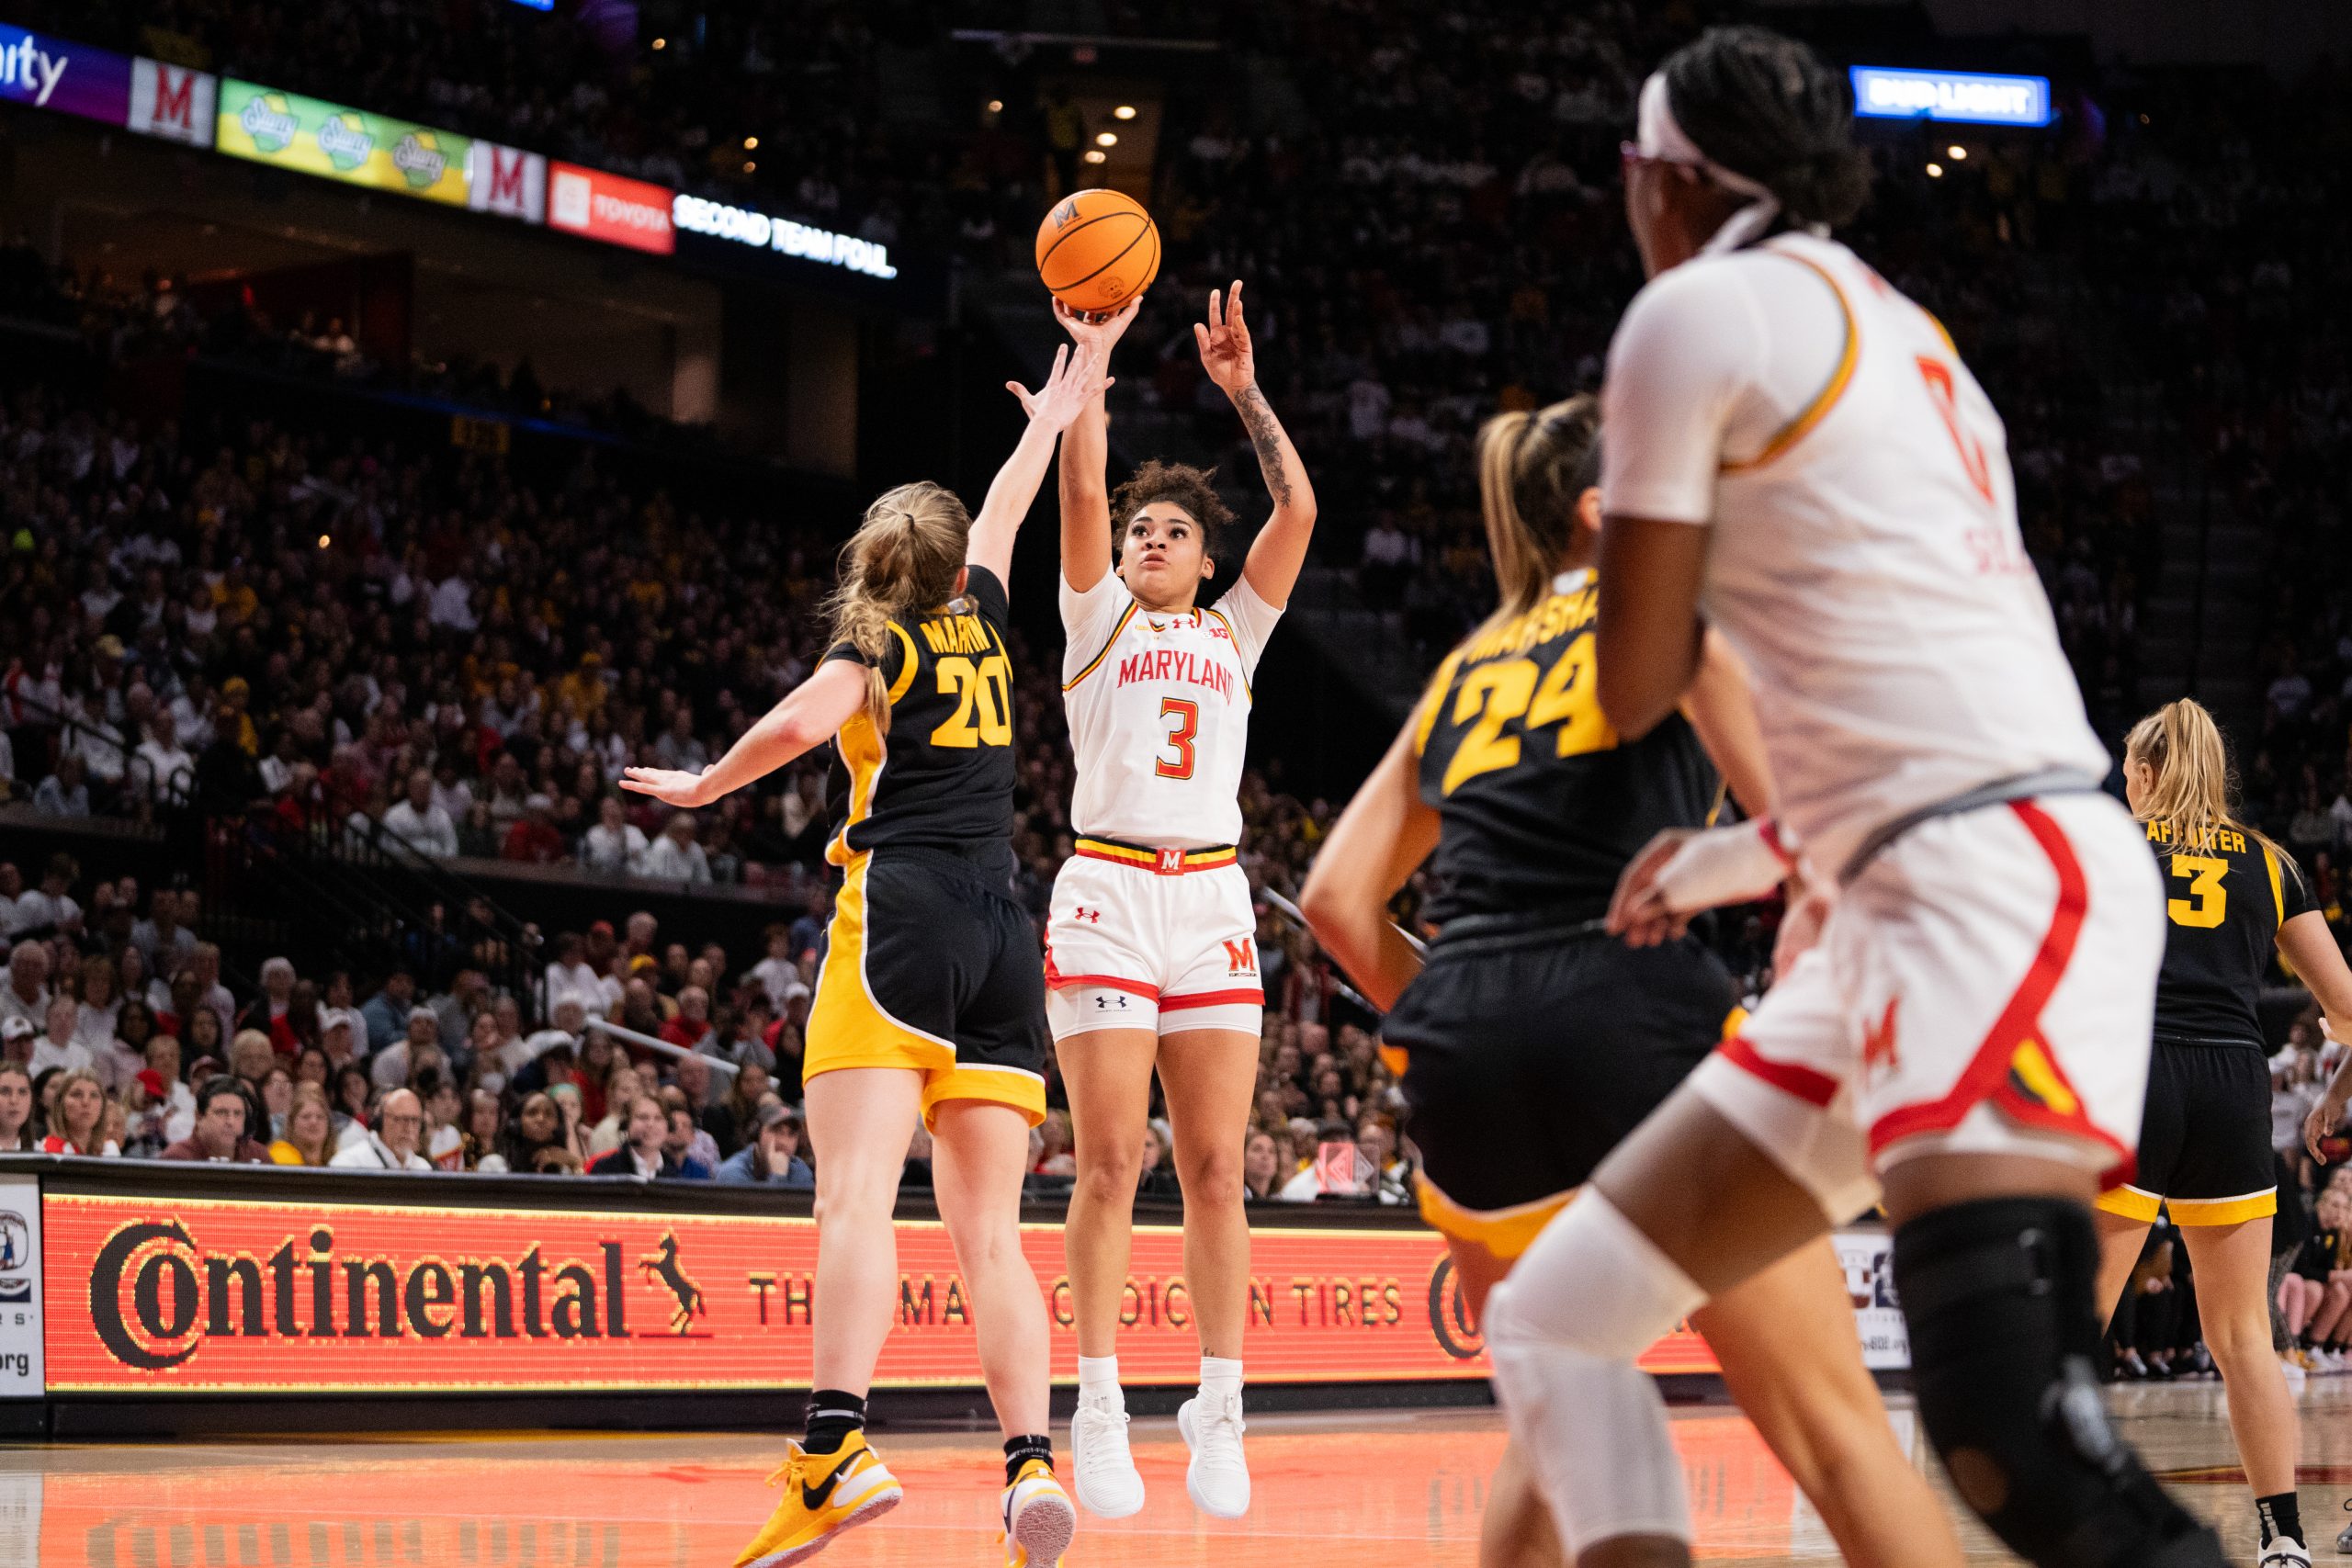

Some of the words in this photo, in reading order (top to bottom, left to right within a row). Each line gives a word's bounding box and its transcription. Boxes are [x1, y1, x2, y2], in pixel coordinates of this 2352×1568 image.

[0, 35, 68, 107] ity
[593, 193, 671, 233] TOYOTA
[673, 194, 772, 247] SECOND
[770, 217, 832, 264] TEAM
[1054, 201, 1080, 228] M
[930, 656, 1012, 748] 20
[1117, 649, 1234, 706] MARYLAND
[1155, 696, 1199, 780] 3
[1441, 631, 1618, 797] 24
[1161, 852, 1182, 870] M
[2168, 853, 2229, 929] 3
[1222, 937, 1256, 972] M
[89, 1214, 631, 1371] Continental
[748, 1275, 814, 1325] TH
[1291, 1281, 1402, 1326] TIRES
